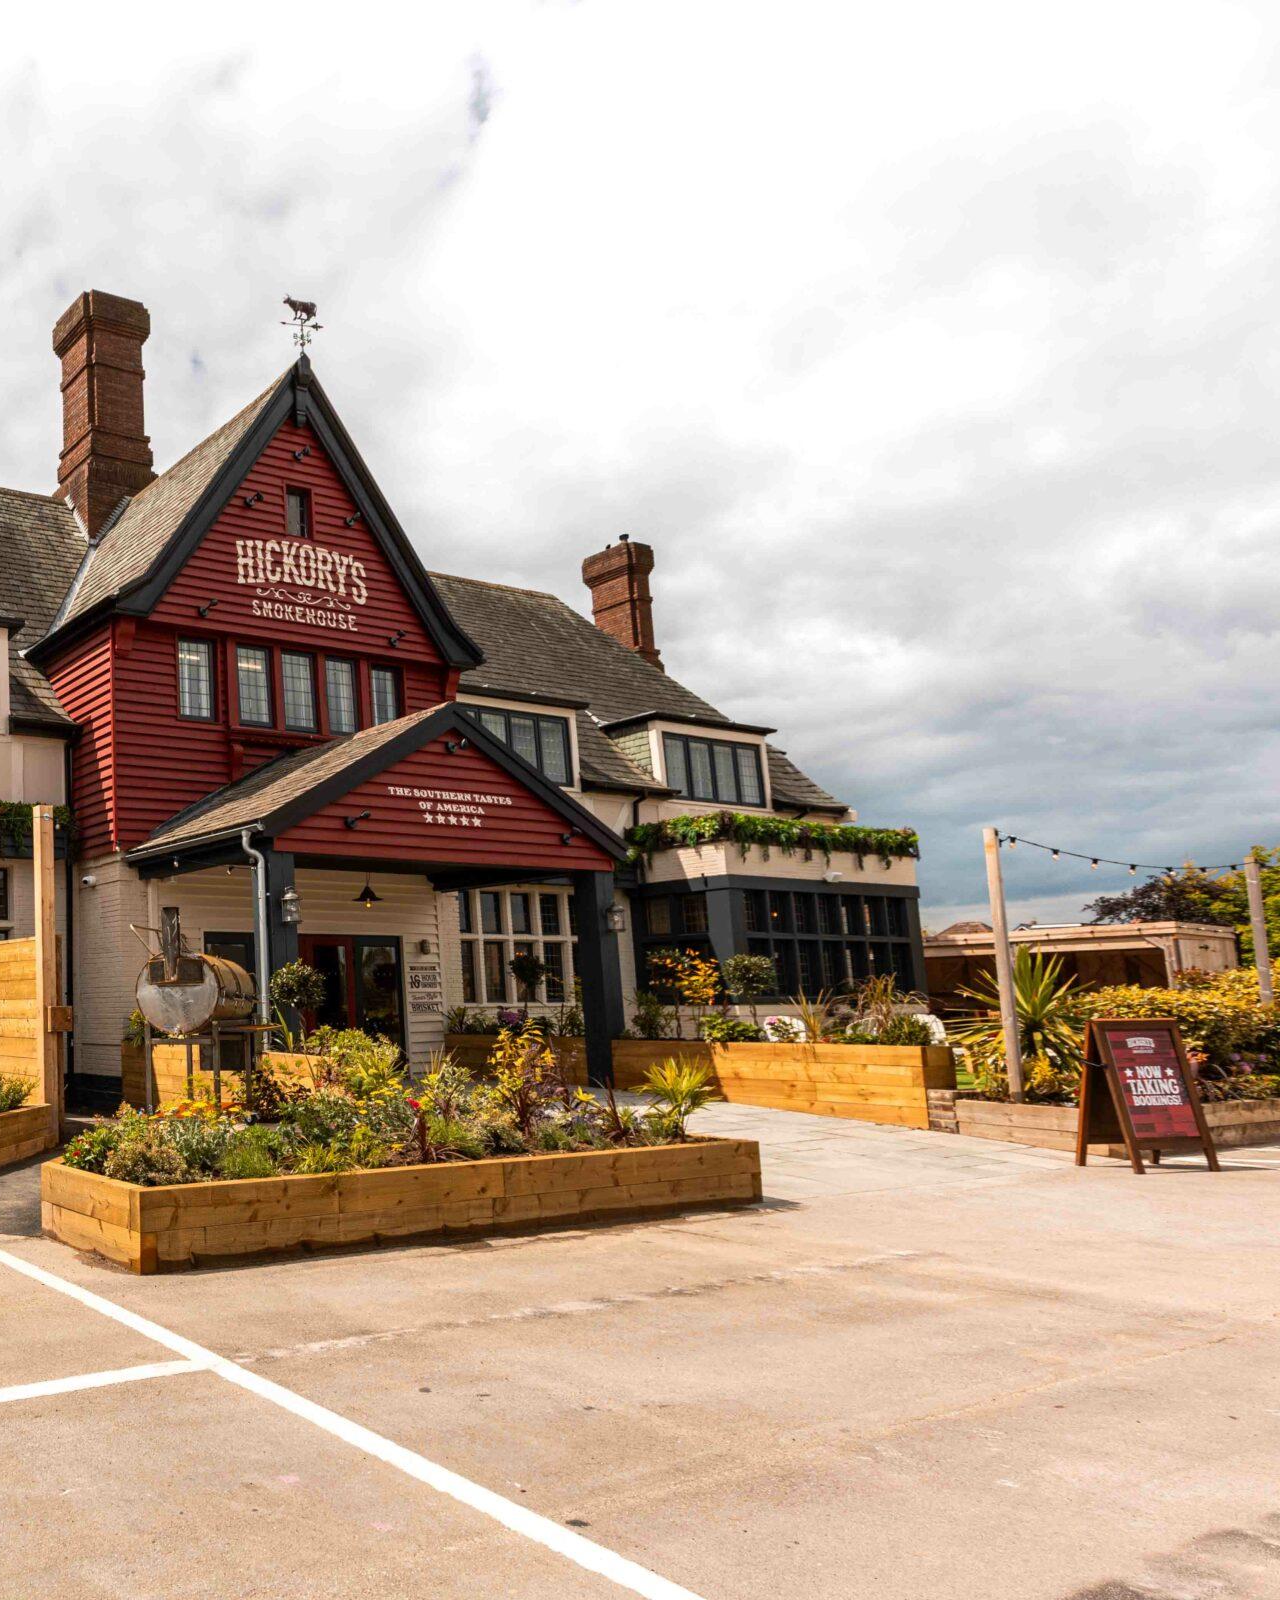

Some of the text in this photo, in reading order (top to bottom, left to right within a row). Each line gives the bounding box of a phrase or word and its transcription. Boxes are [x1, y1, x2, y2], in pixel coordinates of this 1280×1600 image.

[236, 540, 368, 605] HICKORY'S
[252, 600, 358, 631] SMOKEHOUSE
[388, 786, 512, 805] THE SOUTHERN TASTES
[419, 801, 485, 815] OF AMERICA
[411, 1003, 440, 1012] BRISKET
[1135, 1065, 1162, 1079] NOW
[1126, 1079, 1180, 1095] TAKING
[1131, 1095, 1183, 1106] BOOKINGS!
